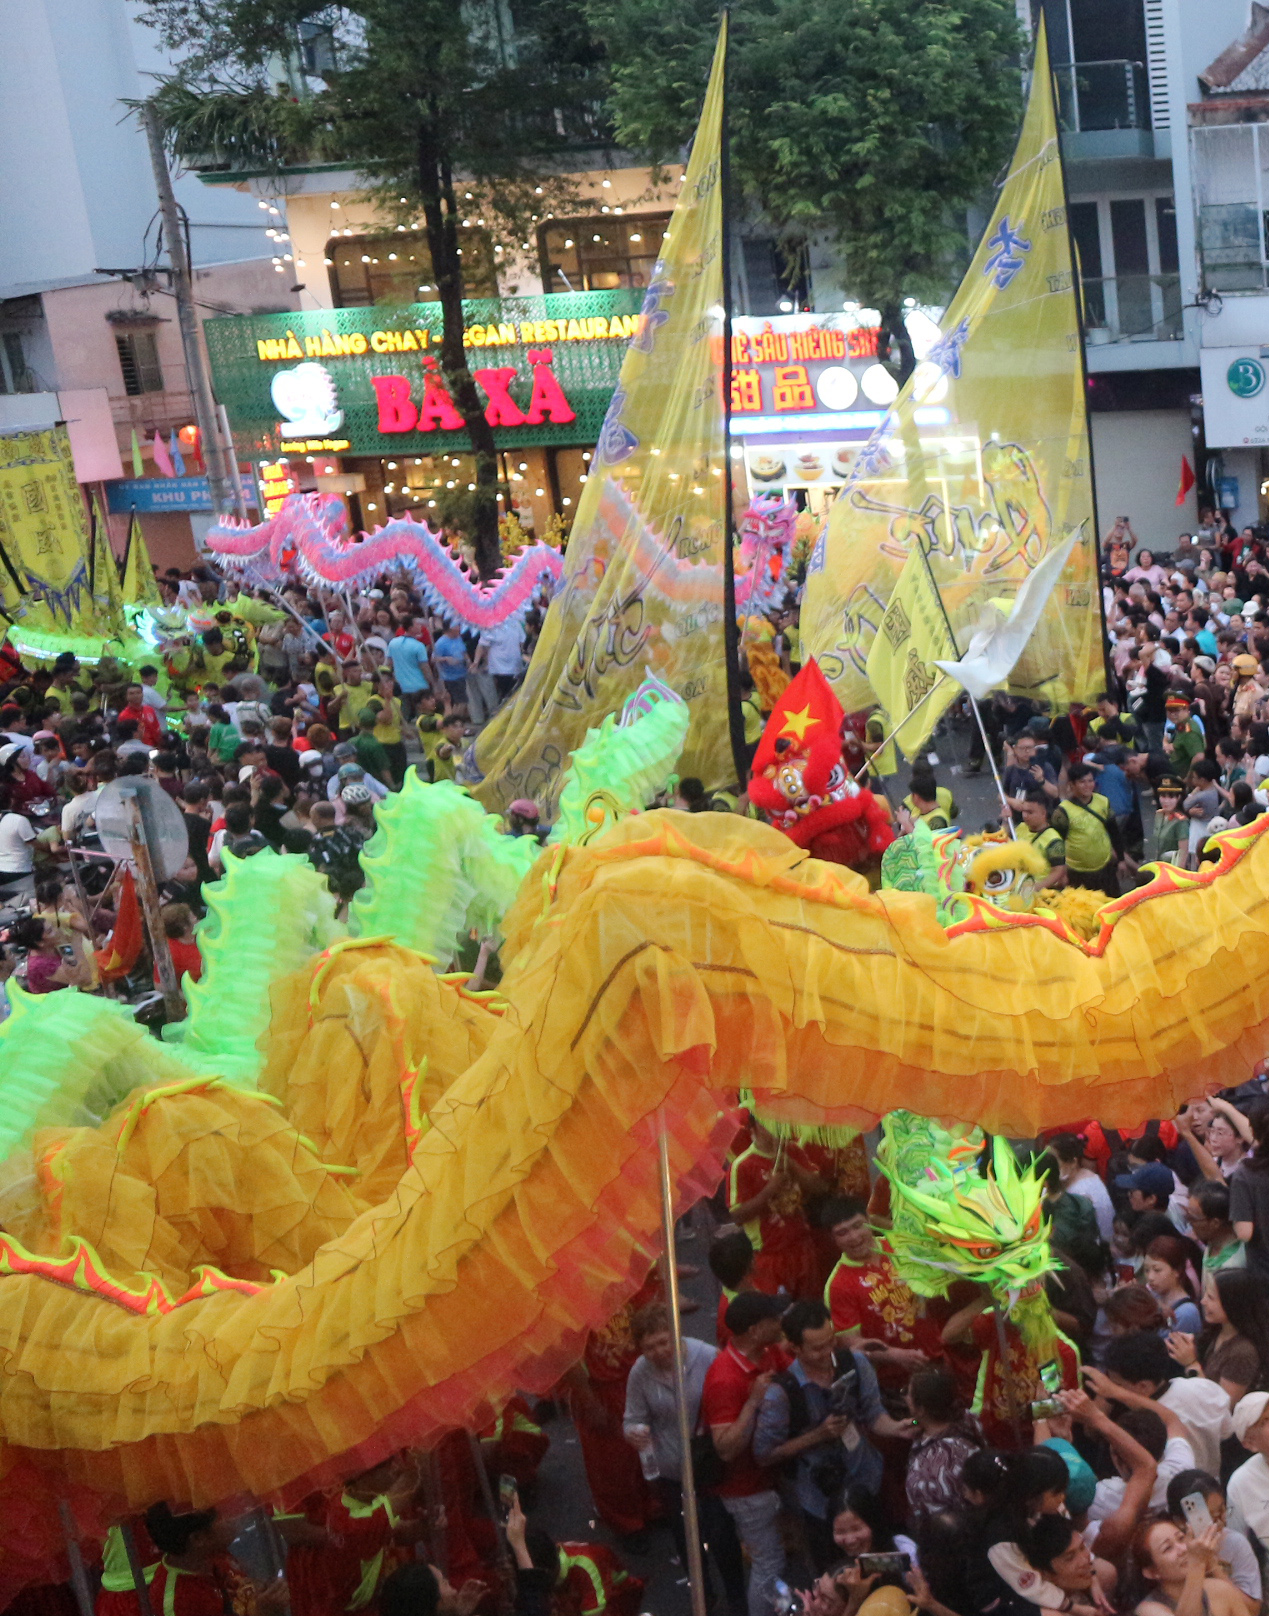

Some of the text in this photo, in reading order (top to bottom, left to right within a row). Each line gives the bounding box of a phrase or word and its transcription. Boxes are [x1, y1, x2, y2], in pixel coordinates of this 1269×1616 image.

[257, 330, 305, 360] NHÀ
[305, 328, 368, 357] HÀNG
[370, 329, 430, 353] CHAY
[751, 320, 789, 364] SẦU
[789, 324, 847, 362] RIÊNG
[472, 348, 577, 427] XÃ
[152, 490, 187, 504] KHU
